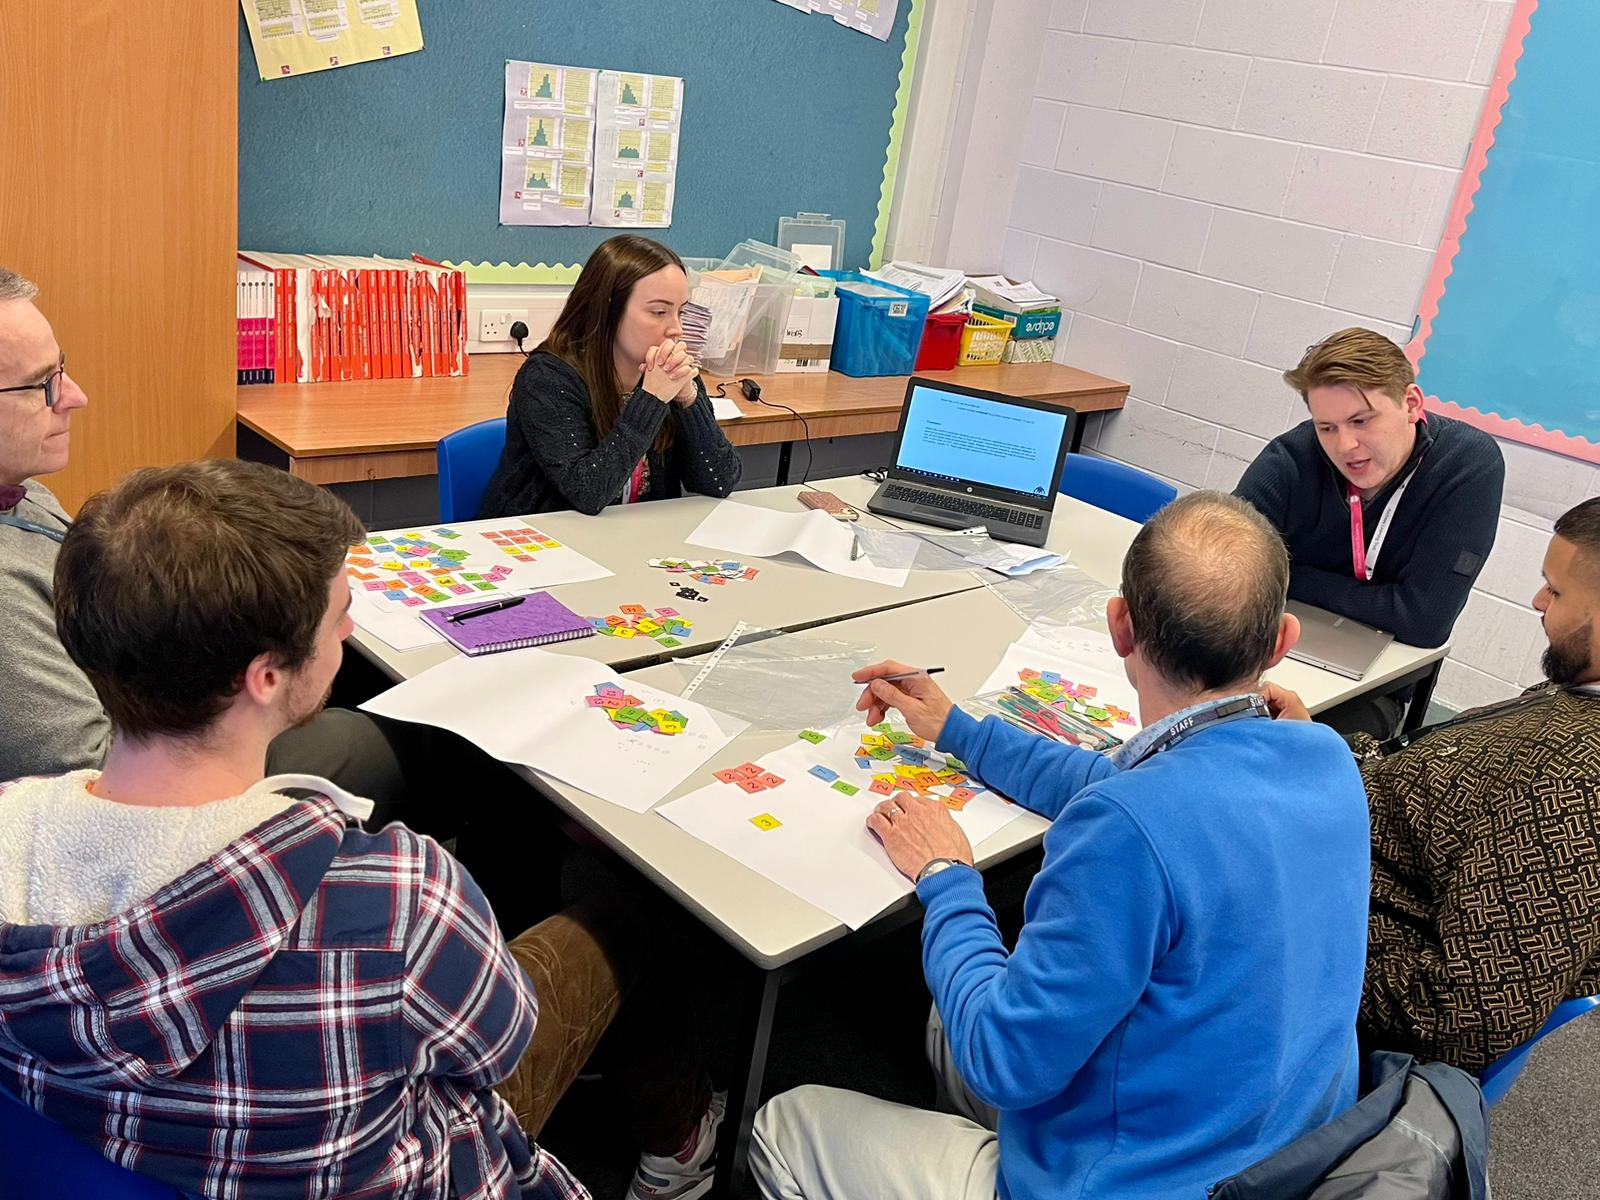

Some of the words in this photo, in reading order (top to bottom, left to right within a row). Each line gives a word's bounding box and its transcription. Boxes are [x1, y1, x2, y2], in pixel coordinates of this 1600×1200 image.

[1025, 321, 1055, 334] eclipse
[1170, 717, 1194, 736] STAFF
[725, 772, 735, 780] 2
[922, 775, 934, 783] 11
[761, 819, 772, 827] 3
